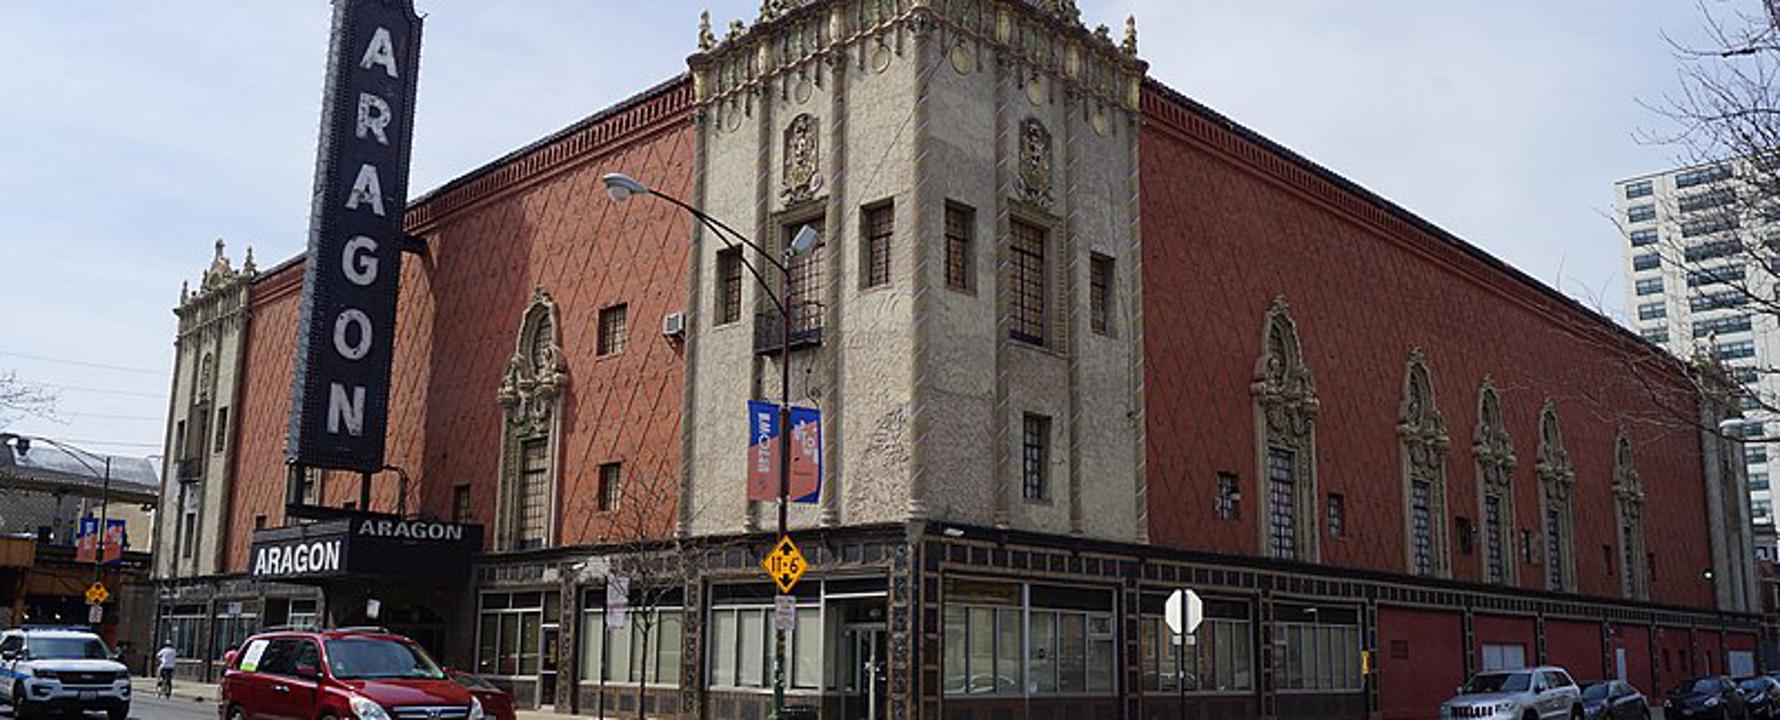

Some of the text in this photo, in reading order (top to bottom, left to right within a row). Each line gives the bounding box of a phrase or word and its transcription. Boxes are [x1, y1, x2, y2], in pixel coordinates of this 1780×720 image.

[326, 26, 399, 436] ARAGON
[358, 519, 463, 540] ARAGON
[254, 541, 341, 575] ARAGON
